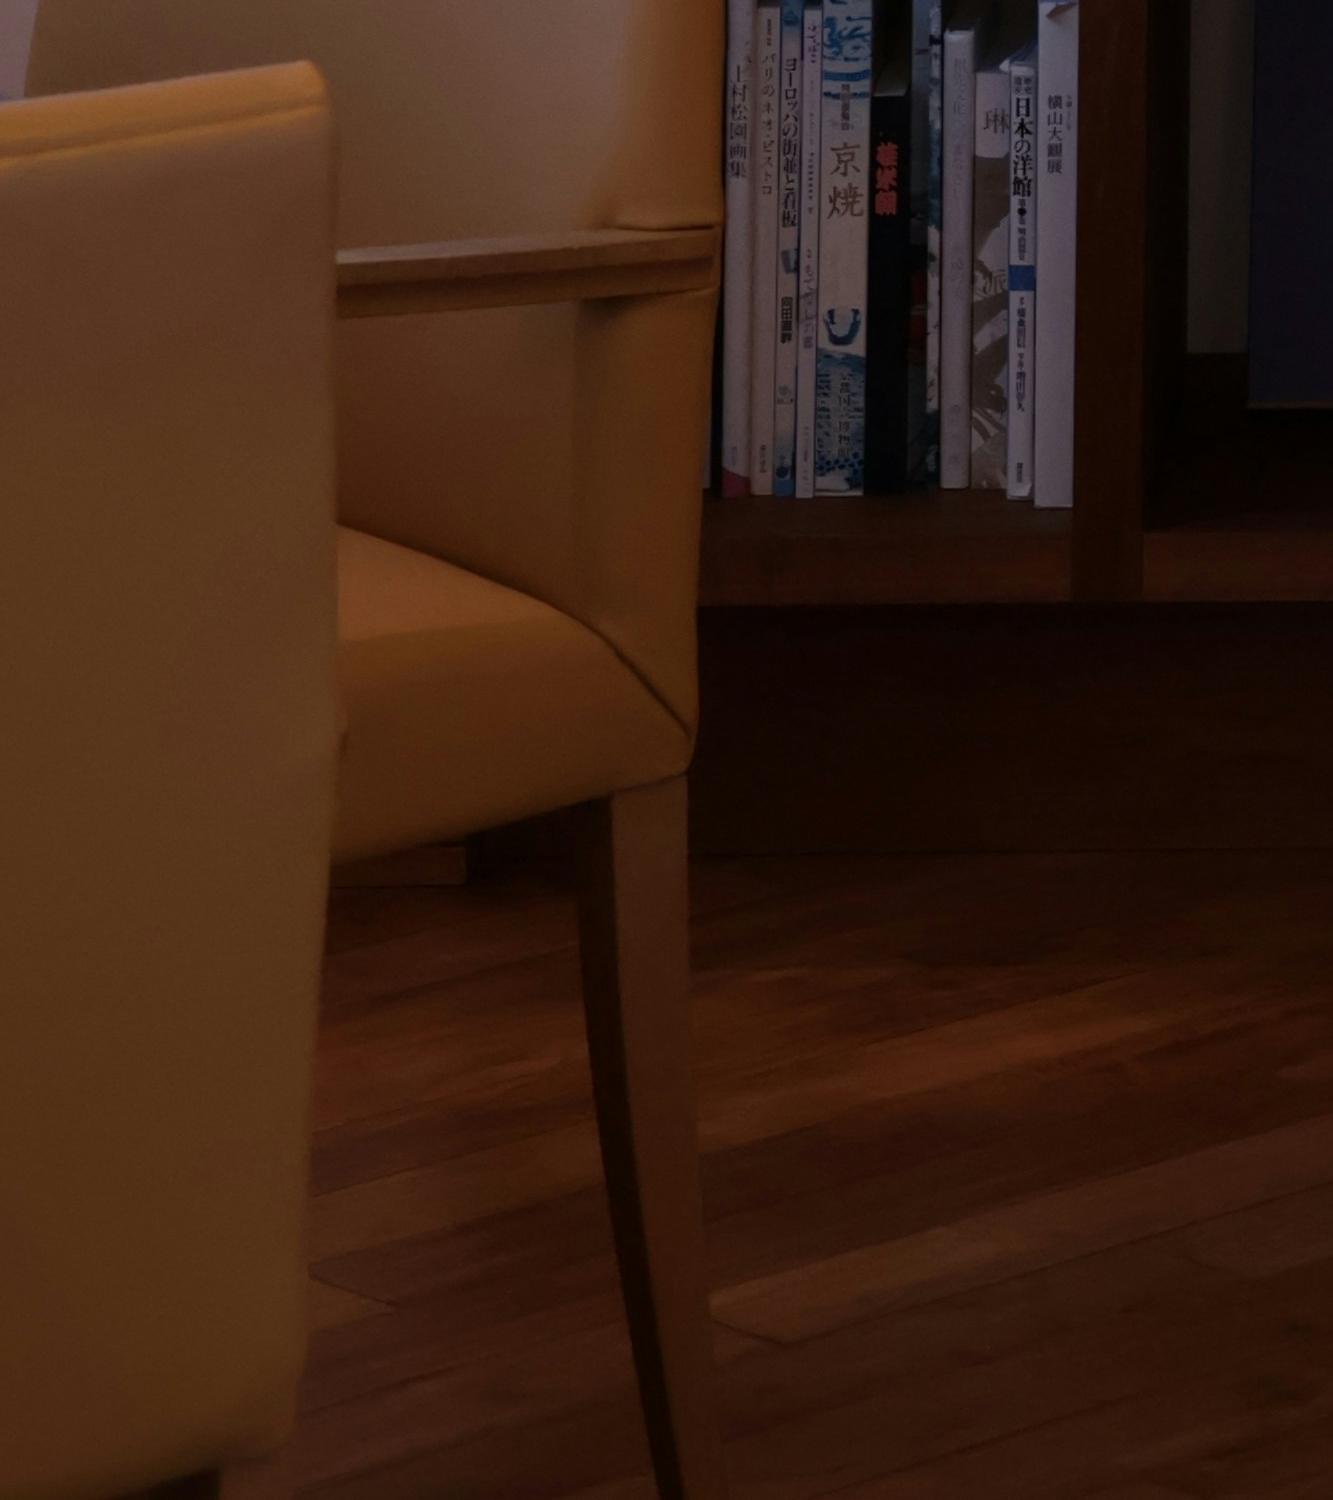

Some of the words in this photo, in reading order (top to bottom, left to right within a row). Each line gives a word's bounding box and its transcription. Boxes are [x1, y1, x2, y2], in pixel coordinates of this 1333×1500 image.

[781, 57, 799, 229] ヨーロッパの街並と看板
[826, 141, 865, 220] 京焼
[1012, 97, 1033, 198] 日本の洋館
[1047, 94, 1063, 176] 横山大観展
